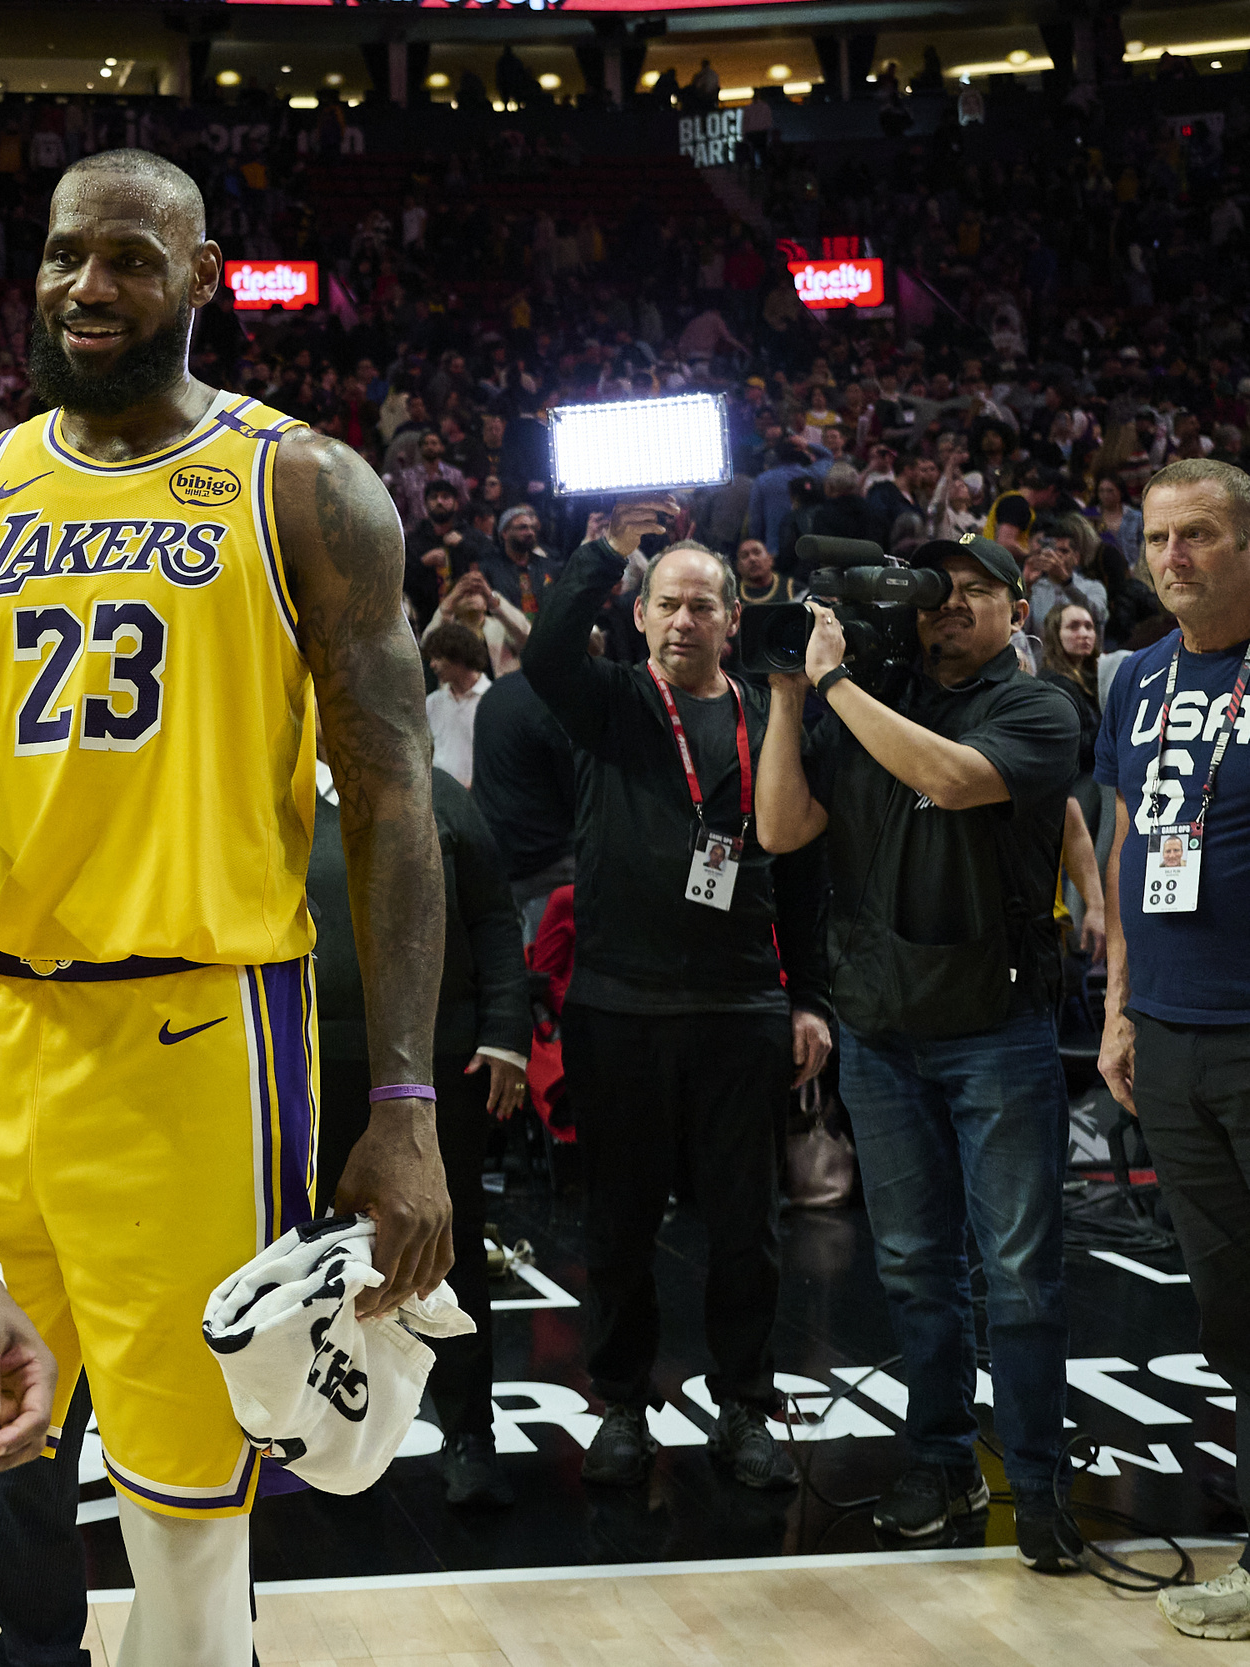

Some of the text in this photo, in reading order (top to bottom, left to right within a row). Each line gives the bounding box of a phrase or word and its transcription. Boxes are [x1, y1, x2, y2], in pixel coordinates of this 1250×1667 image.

[176, 473, 237, 496] bibigo
[13, 599, 168, 757] 23
[1131, 690, 1250, 746] USA
[1134, 749, 1194, 835] 6
